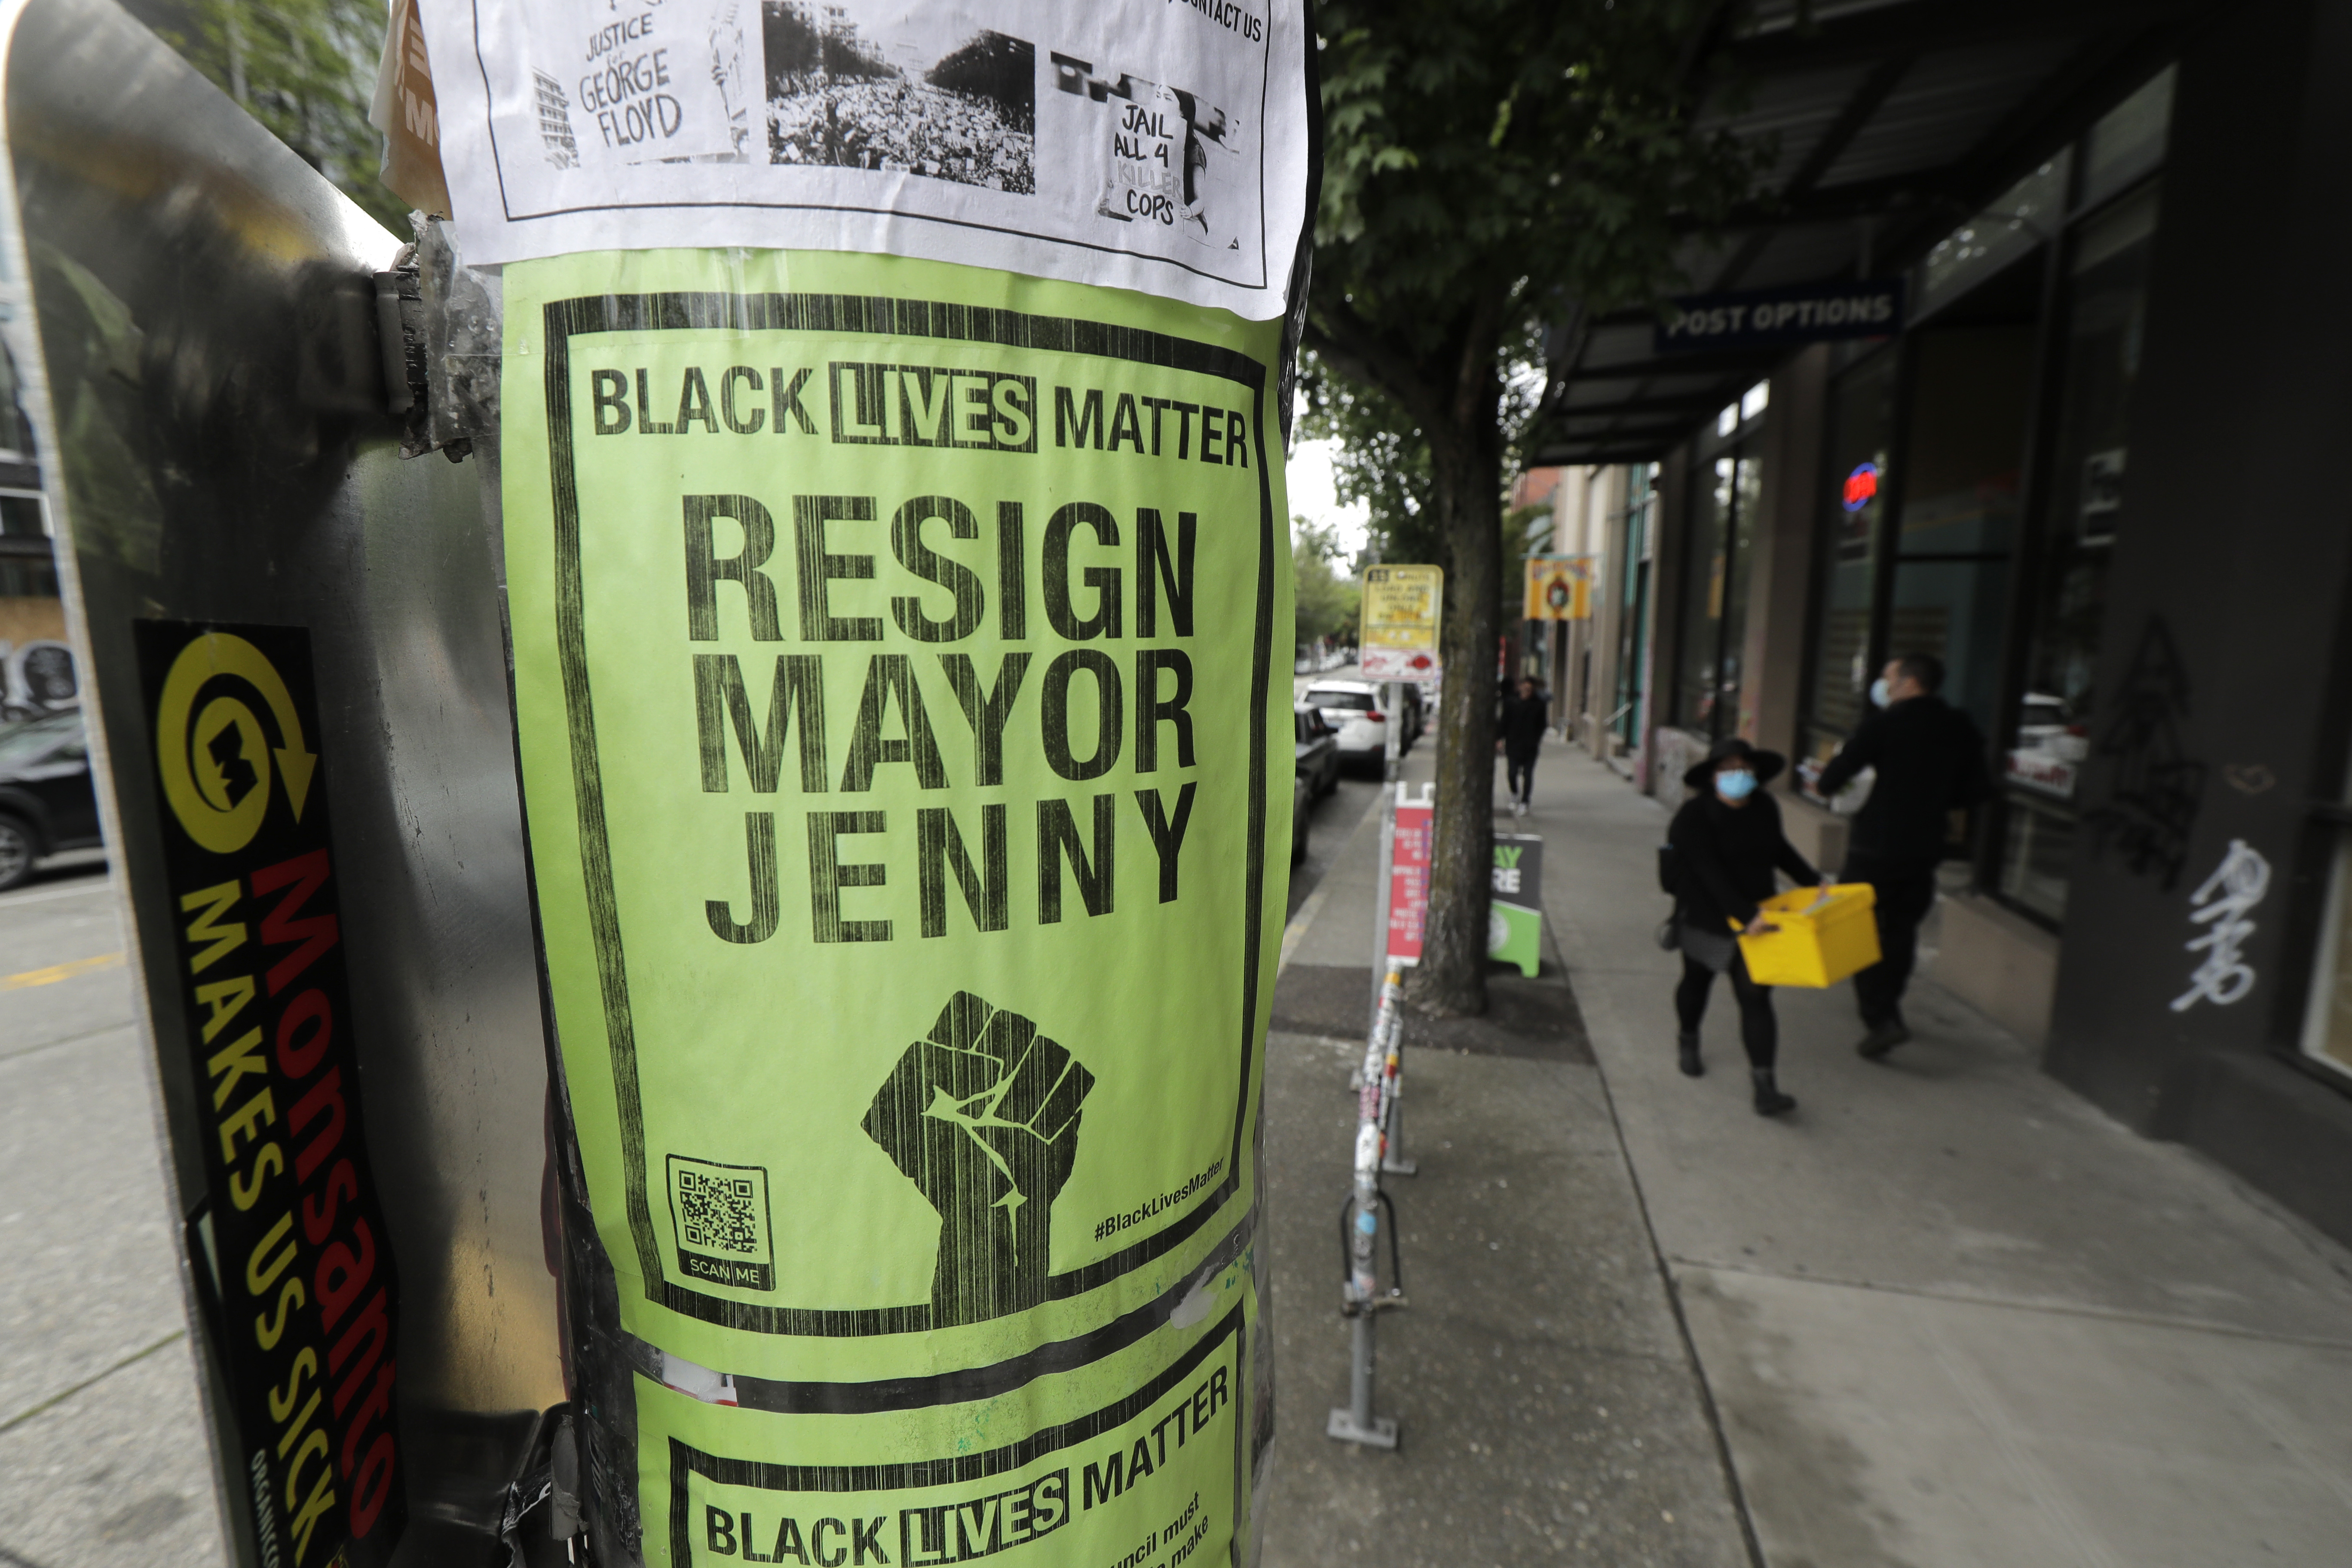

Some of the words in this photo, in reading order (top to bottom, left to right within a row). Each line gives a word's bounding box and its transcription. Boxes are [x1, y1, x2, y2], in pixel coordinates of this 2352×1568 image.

[586, 12, 652, 61] JUSTICE
[1183, 0, 1241, 32] NTACT
[1244, 12, 1261, 42] US
[579, 47, 670, 113] GEORGE
[597, 93, 682, 147] FLOYD
[1114, 132, 1147, 160] ALL
[1155, 143, 1169, 168] 4
[1122, 104, 1173, 139] JAIL
[1118, 160, 1184, 200] KILLER
[1127, 189, 1173, 226] COPS
[1668, 306, 1747, 338] POST
[1752, 294, 1893, 330] OPTIONS
[592, 366, 818, 435] BLACK
[840, 368, 1032, 446] LIVES
[1055, 386, 1249, 469] MATTER
[683, 494, 1195, 643] RESIGN
[693, 648, 1197, 793] MAYOR
[705, 781, 1197, 945] JENNY
[180, 879, 284, 1211] MAKES
[250, 848, 396, 1539] Monsanto
[1095, 1157, 1224, 1242] #BlackLivesMatter
[247, 1211, 305, 1351] US
[690, 1259, 730, 1279] SCAN
[736, 1268, 760, 1283] ME
[269, 1347, 336, 1568] SICK
[706, 1504, 890, 1568] BLACK
[909, 1477, 1064, 1562] LIVES
[1083, 1366, 1228, 1510] MATTER
[1163, 1491, 1199, 1545] must
[1172, 1515, 1208, 1568] make
